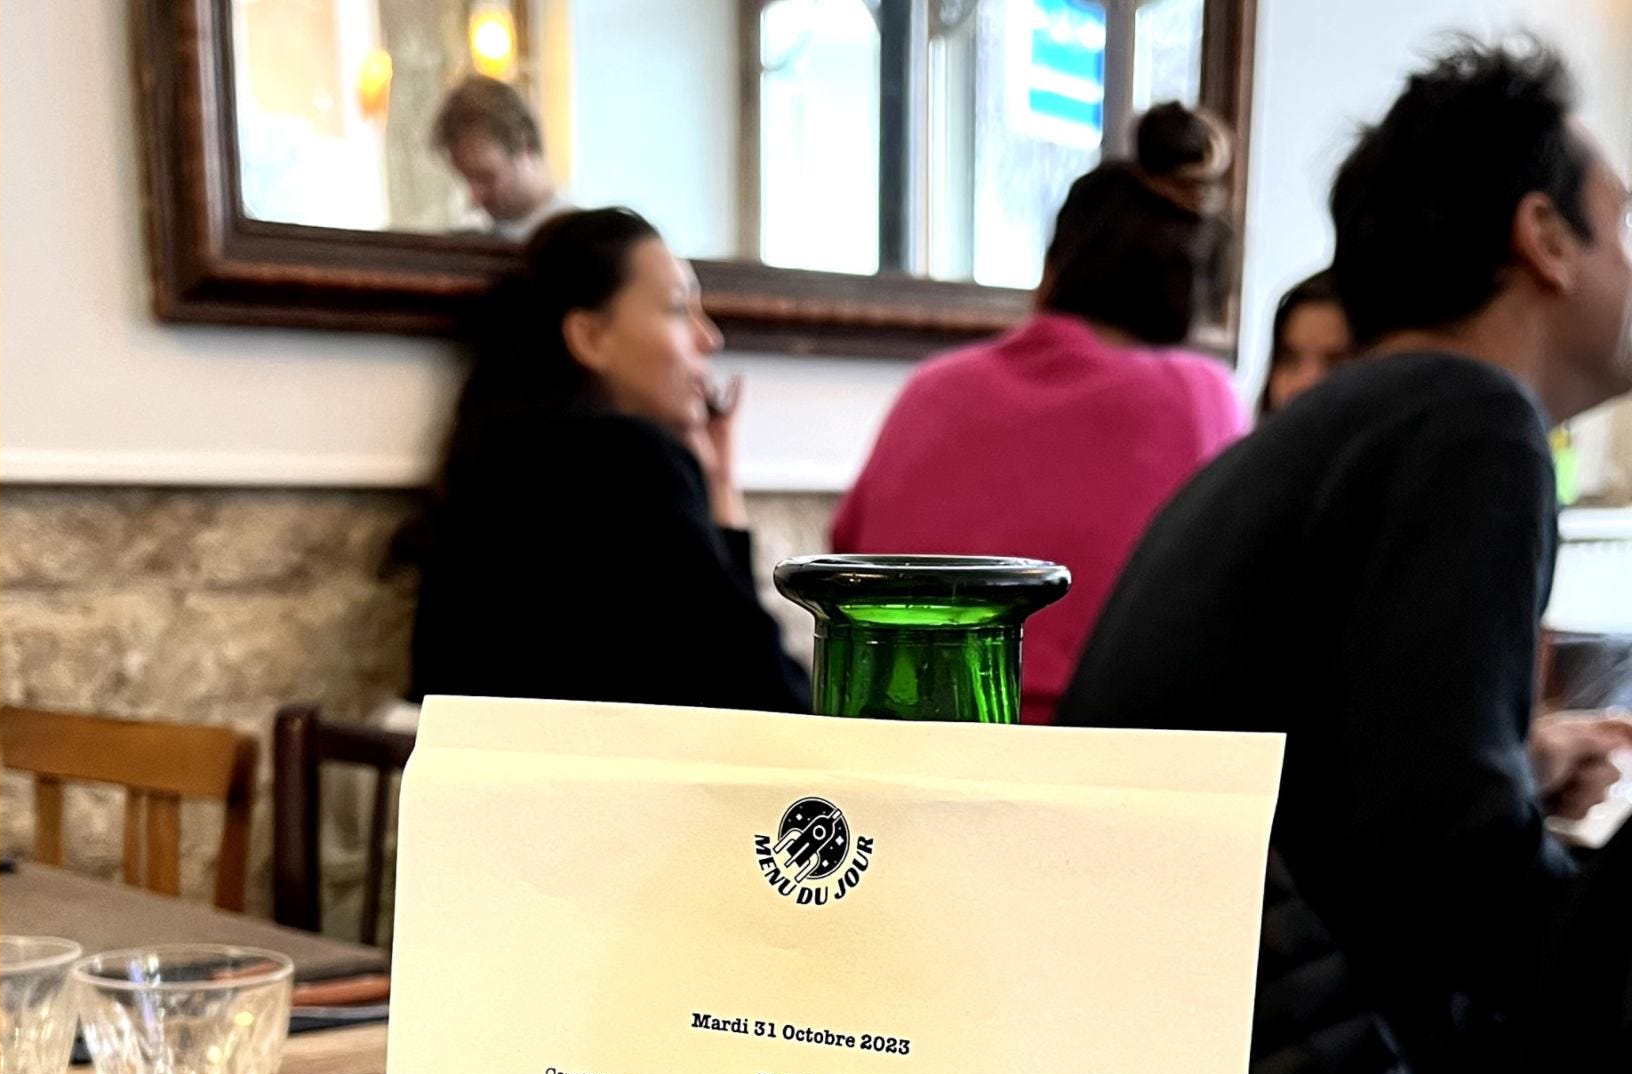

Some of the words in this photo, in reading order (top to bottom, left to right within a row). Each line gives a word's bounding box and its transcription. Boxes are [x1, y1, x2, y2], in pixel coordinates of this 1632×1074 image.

[754, 834, 797, 897] MENU
[796, 886, 829, 906] DU
[834, 835, 874, 900] JOUR
[691, 1013, 749, 1034] Mardi
[754, 1021, 776, 1038] 31
[782, 1024, 855, 1048] Octobre
[860, 1034, 910, 1055] 2023
